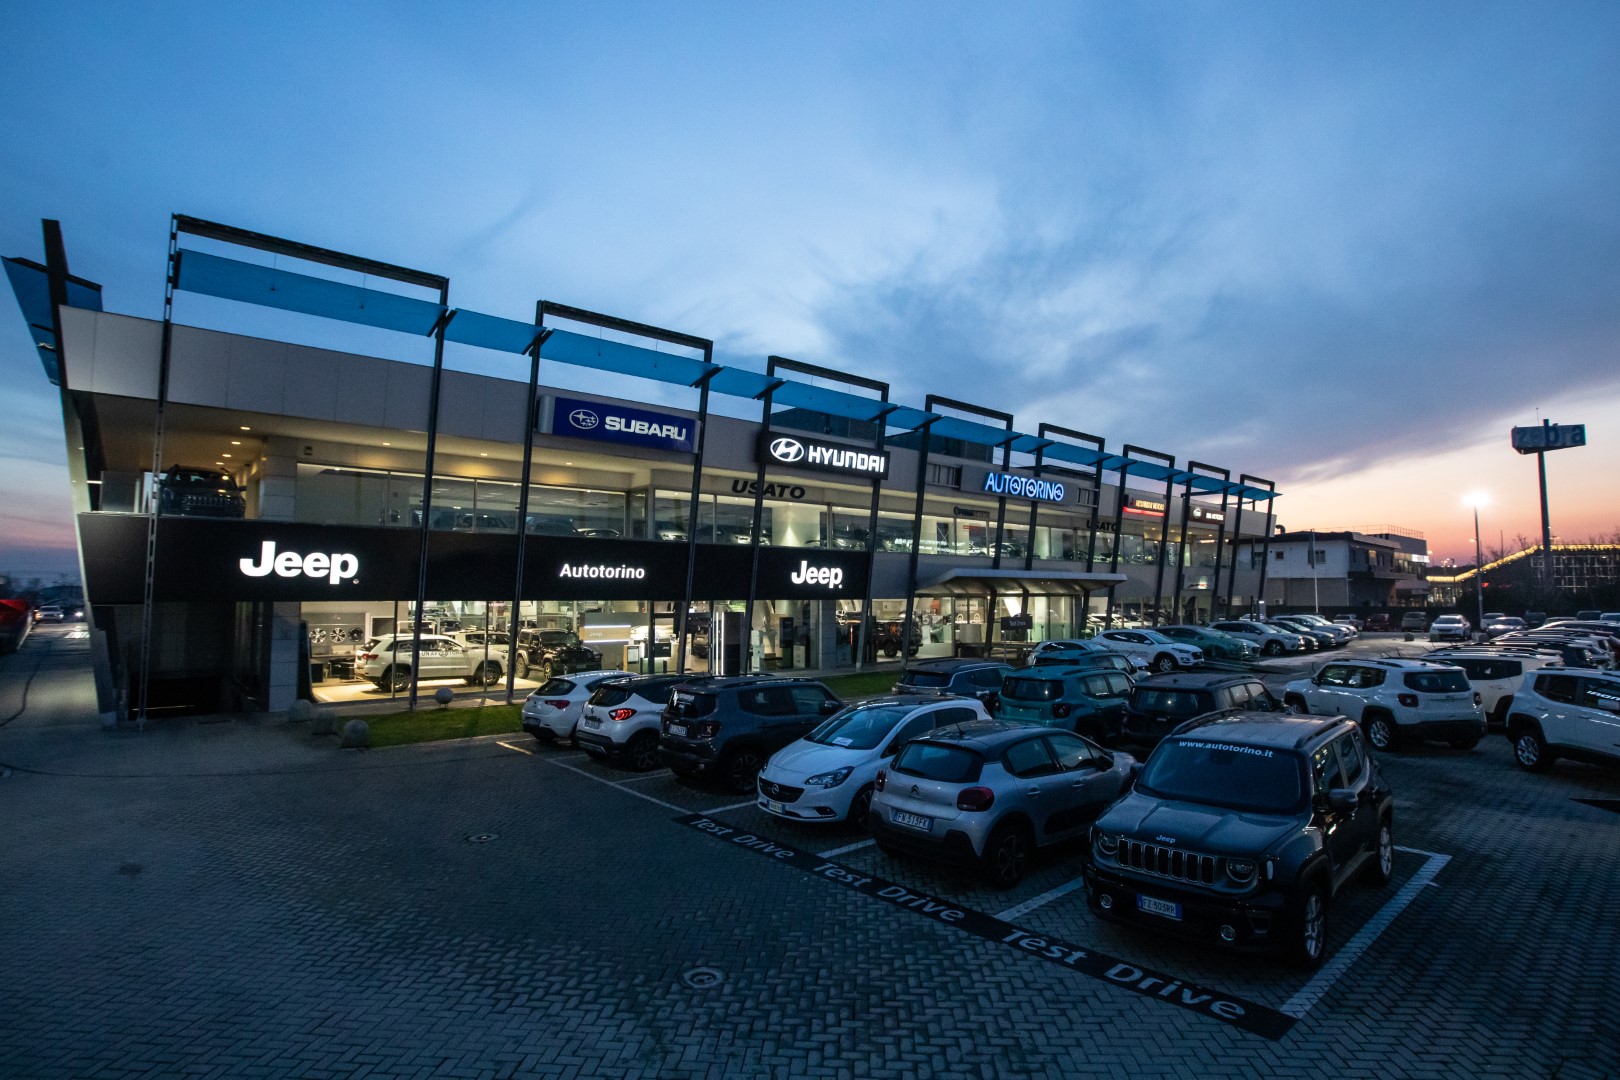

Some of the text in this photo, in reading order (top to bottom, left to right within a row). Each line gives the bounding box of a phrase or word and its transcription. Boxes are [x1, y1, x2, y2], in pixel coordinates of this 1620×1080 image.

[604, 415, 686, 441] SUBARU
[808, 445, 885, 473] HYUNDAI
[985, 472, 1064, 502] AUTOTORINO
[239, 541, 359, 585] Jeep
[559, 563, 645, 579] Autotorino
[791, 561, 843, 588] Jeep
[1179, 741, 1274, 758] www.autotorino.it
[689, 818, 795, 859] Test Drive
[1156, 834, 1176, 844] Jeep
[813, 861, 966, 922] Test Drive
[1002, 929, 1246, 1020] Test Drive
